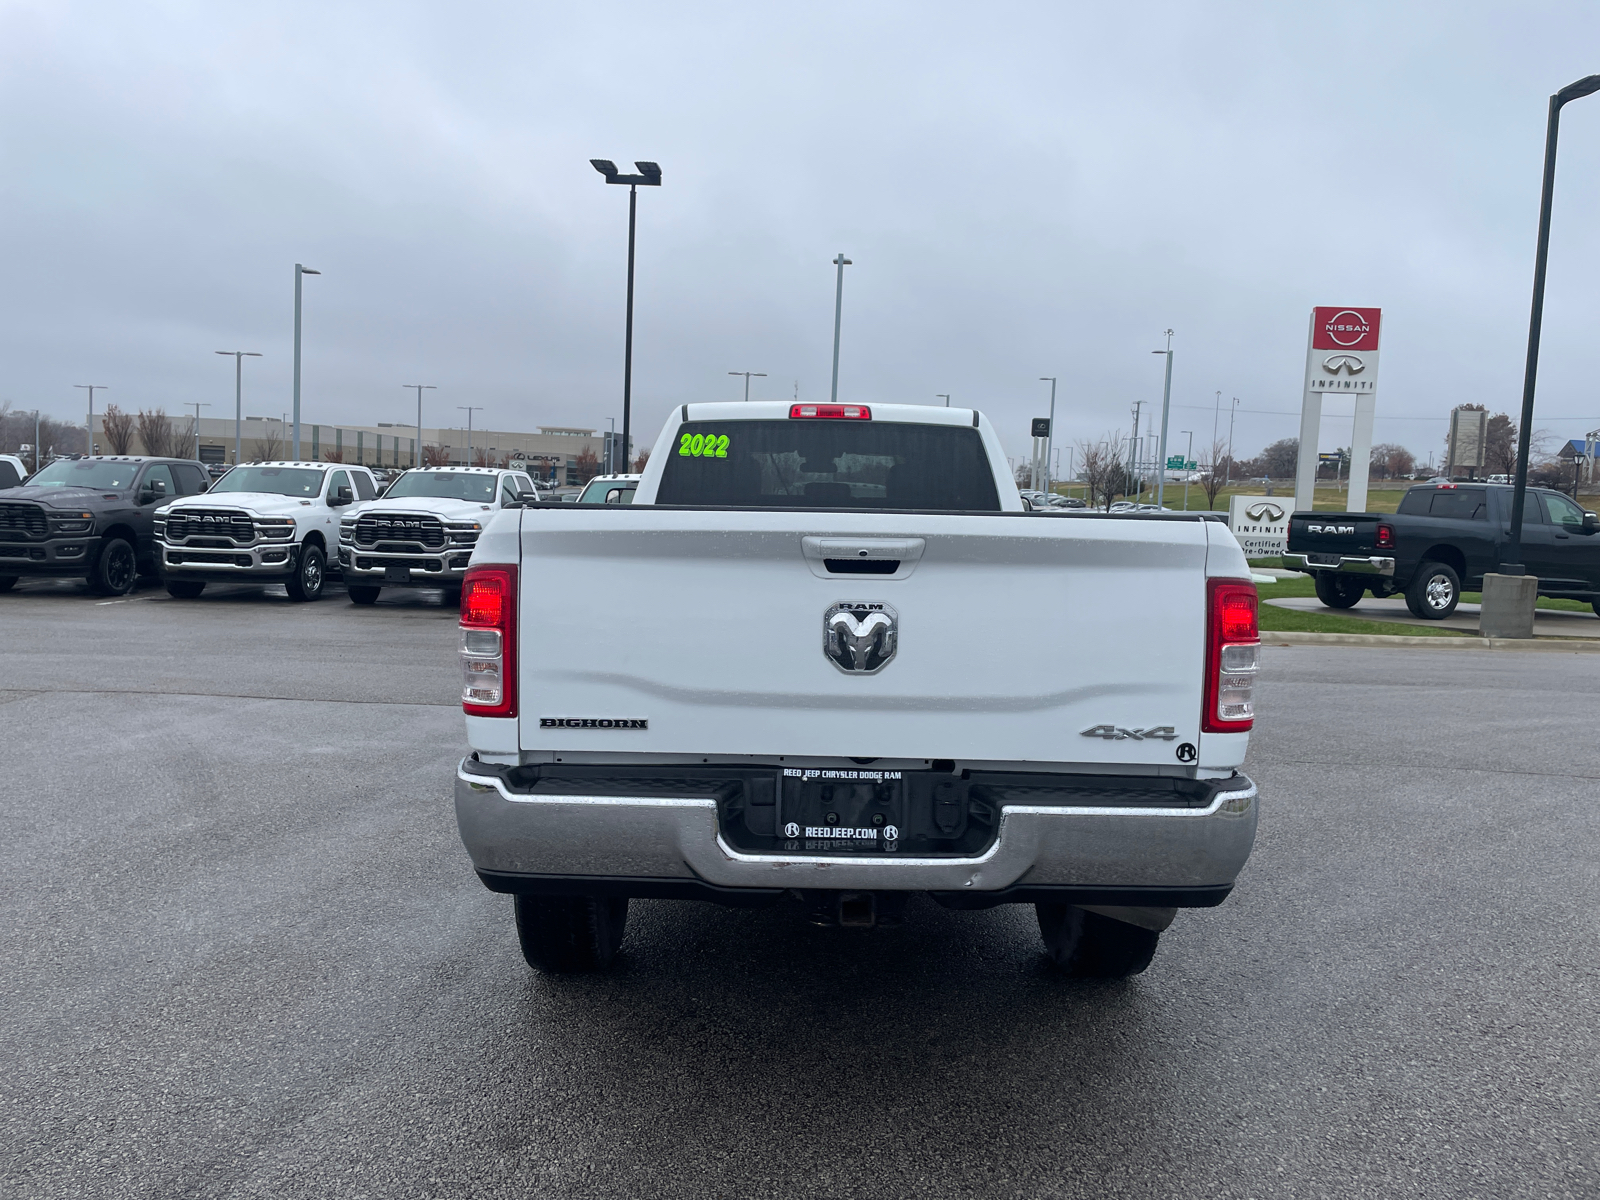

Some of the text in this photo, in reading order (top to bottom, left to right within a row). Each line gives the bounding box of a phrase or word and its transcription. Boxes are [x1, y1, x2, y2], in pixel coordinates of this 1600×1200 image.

[1325, 324, 1370, 332] NISSAN
[1312, 380, 1373, 389] INFINITI
[679, 433, 730, 458] 2022
[187, 515, 230, 523] RAM
[377, 520, 420, 528] RAM
[1237, 525, 1285, 534] INFINIT
[1307, 525, 1354, 535] RAM
[1244, 540, 1281, 548] Certified
[540, 718, 648, 729] BIGHORN
[1079, 725, 1180, 741] 4x4
[783, 768, 801, 777] REED
[804, 769, 820, 778] JEEP
[822, 770, 858, 779] CHRYSLER
[859, 771, 883, 779] DODGE
[805, 826, 877, 839] REEDJEEP.COM
